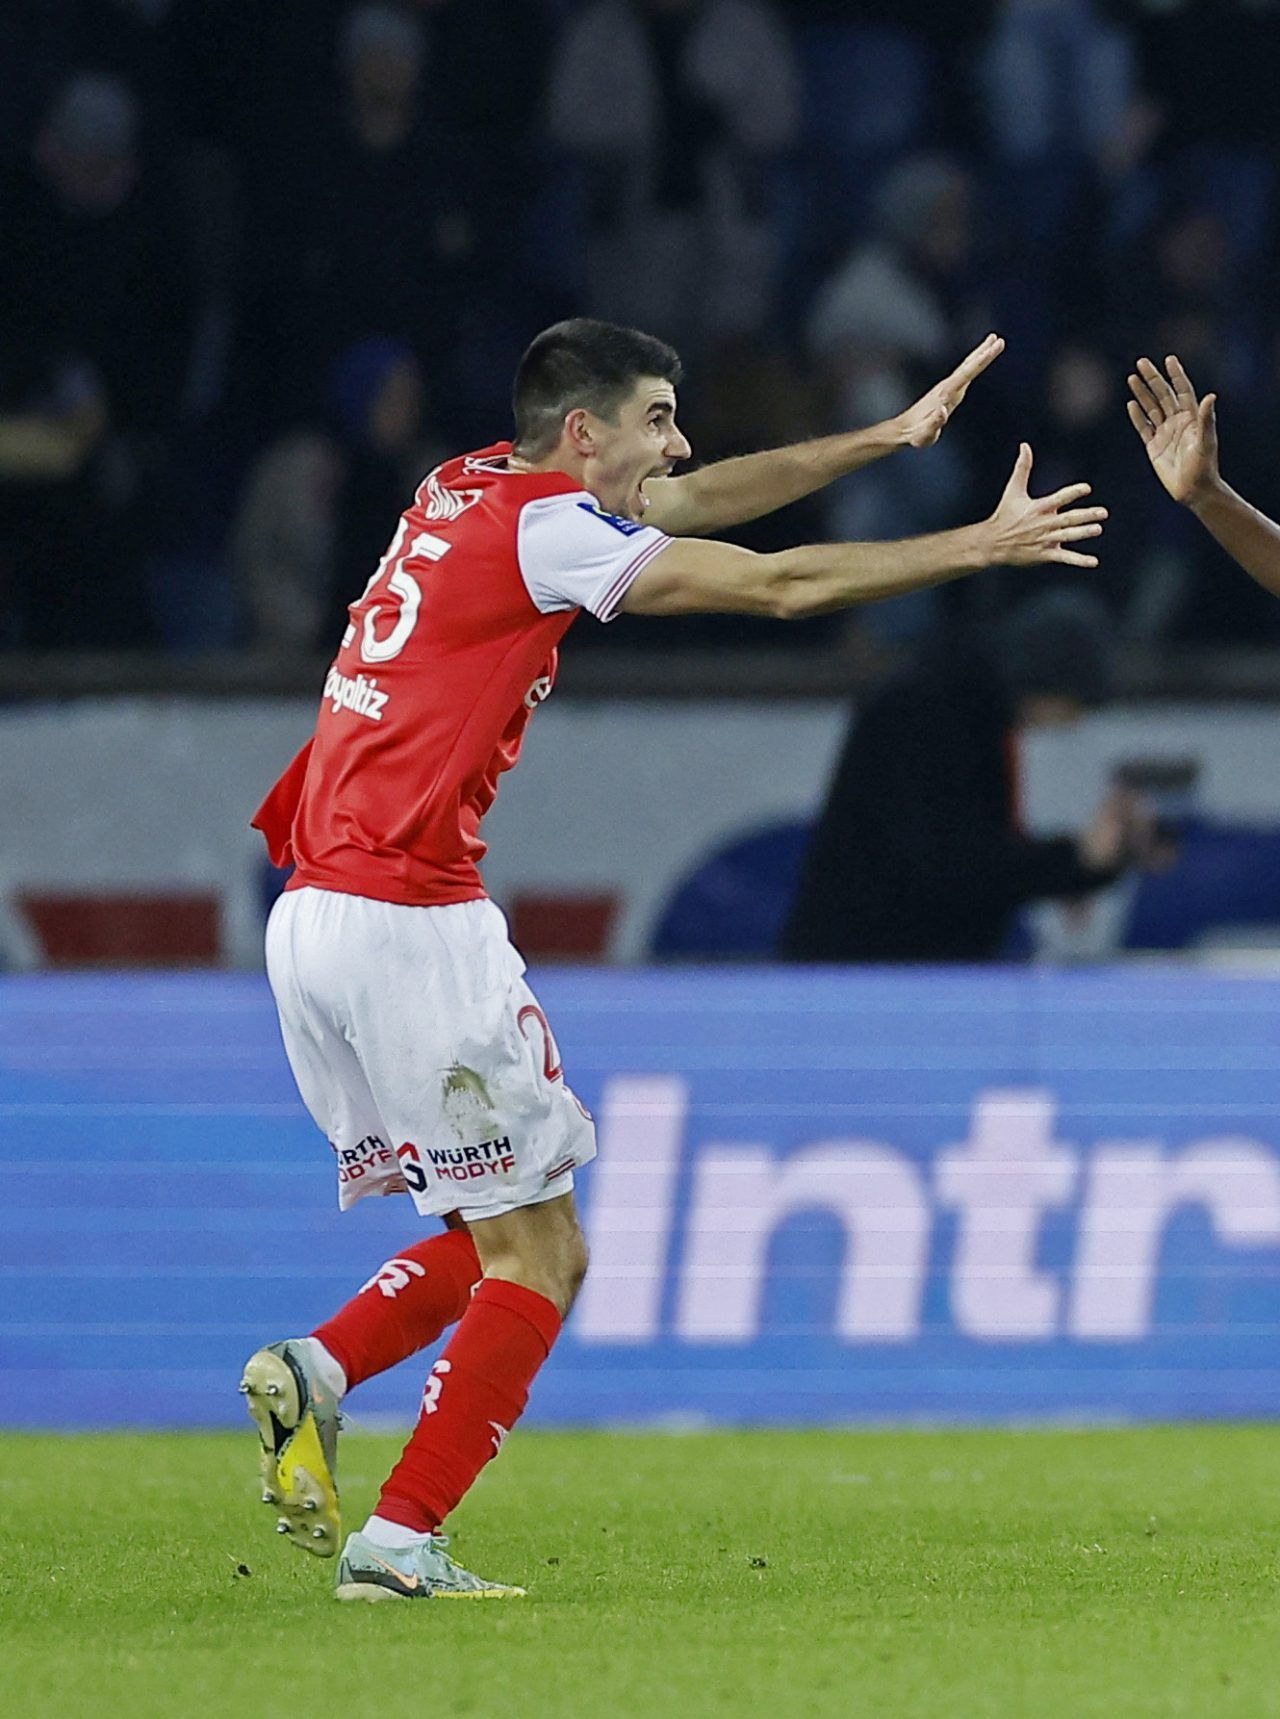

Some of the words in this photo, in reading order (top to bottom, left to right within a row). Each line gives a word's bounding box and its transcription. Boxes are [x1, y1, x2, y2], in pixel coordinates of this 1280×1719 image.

[324, 666, 389, 720] oyaltiz
[427, 1136, 512, 1165] WÜRTH
[435, 1155, 516, 1181] MODYF
